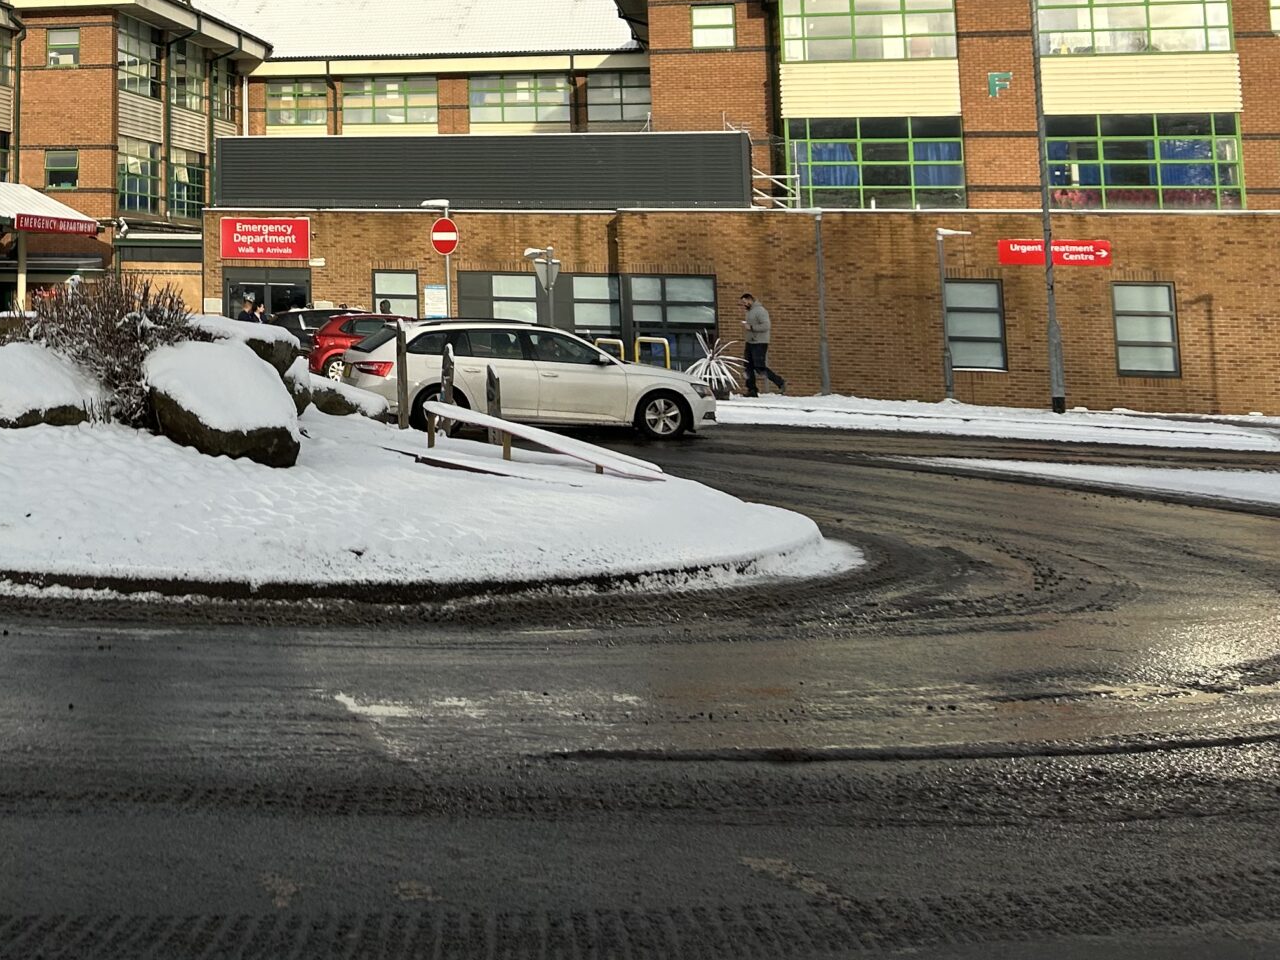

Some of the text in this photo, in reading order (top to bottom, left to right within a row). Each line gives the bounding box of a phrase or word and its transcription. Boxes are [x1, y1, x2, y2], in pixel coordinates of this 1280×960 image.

[987, 72, 1013, 97] F
[20, 216, 95, 233] EMERGENCY DEPARTMENT
[236, 222, 293, 234] Emergency
[233, 233, 296, 245] Department
[238, 246, 293, 254] Walk In Arrivals
[1010, 244, 1094, 253] Urgent reatment
[1063, 252, 1094, 260] Centre
